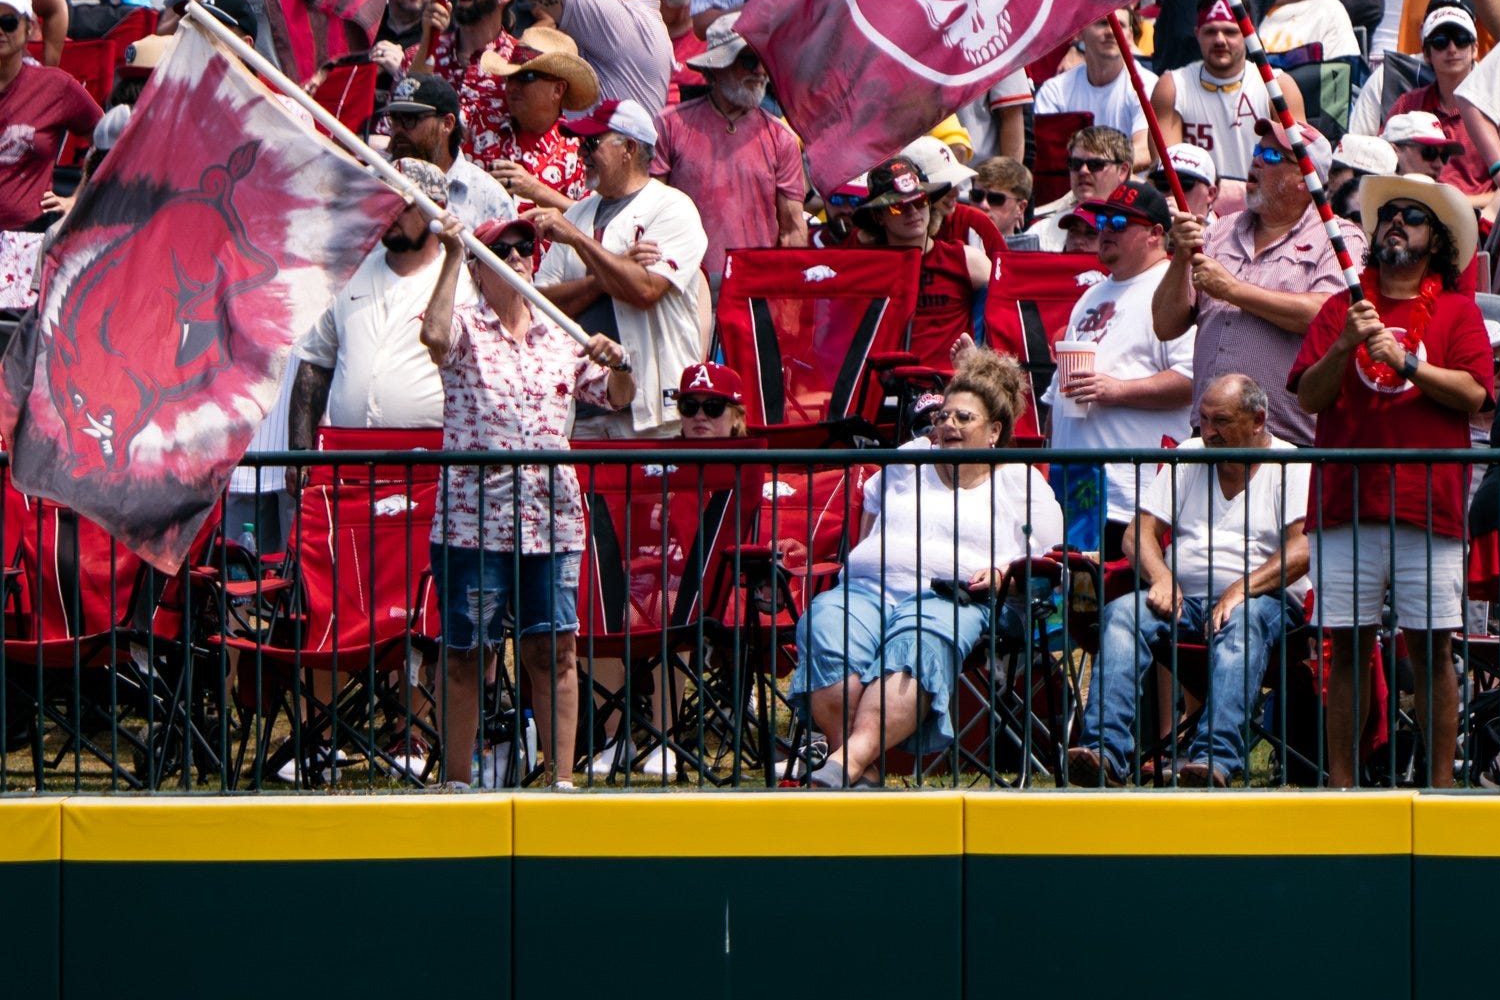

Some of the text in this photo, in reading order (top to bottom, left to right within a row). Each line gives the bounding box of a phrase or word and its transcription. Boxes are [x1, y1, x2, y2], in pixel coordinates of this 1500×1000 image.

[1206, 0, 1232, 21] A
[1229, 91, 1260, 130] A
[1182, 122, 1214, 152] 55
[689, 364, 714, 390] A
